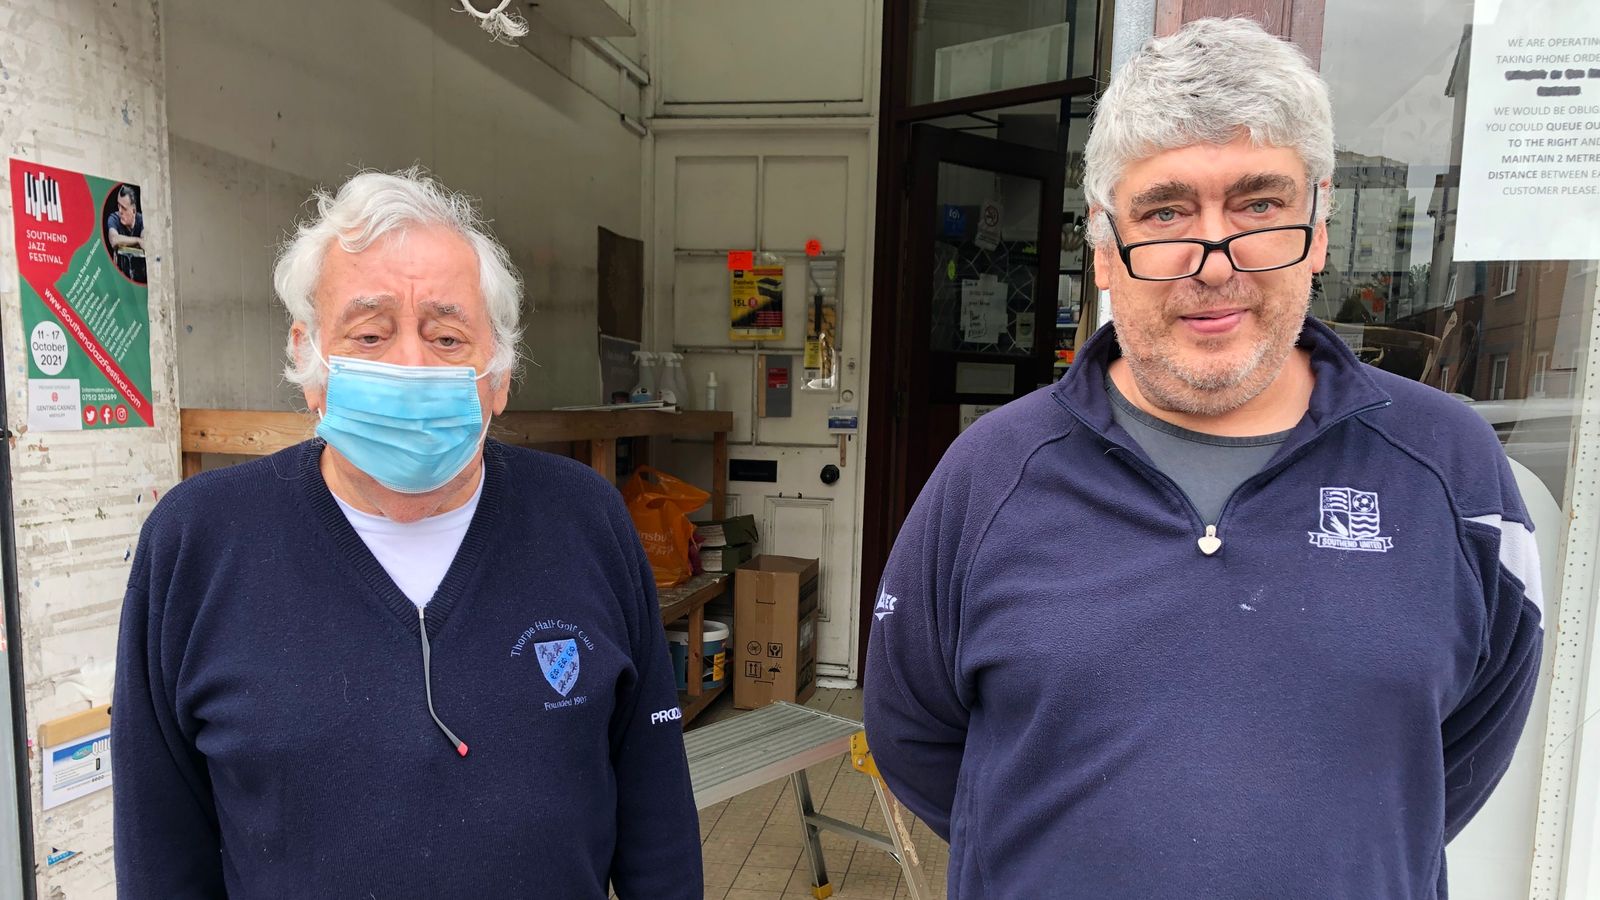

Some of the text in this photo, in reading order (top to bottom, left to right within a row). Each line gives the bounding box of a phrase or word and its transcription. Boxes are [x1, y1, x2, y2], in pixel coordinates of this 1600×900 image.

[1508, 38, 1524, 47] WE
[1527, 38, 1545, 47] ARE
[1496, 54, 1533, 64] TAKING
[1535, 54, 1571, 63] PHONE
[1494, 106, 1510, 116] WE
[1513, 106, 1551, 115] WOULD
[1553, 105, 1566, 115] BE
[1486, 122, 1507, 132] YOU
[1509, 122, 1544, 131] COULD
[1546, 121, 1582, 131] QUEUE
[1508, 138, 1522, 148] TO
[1525, 138, 1545, 147] THE
[1547, 137, 1578, 147] RIGHT
[1501, 154, 1555, 164] MAINTAIN
[1557, 154, 1563, 163] 2
[1488, 170, 1538, 180] DISTANCE
[1541, 169, 1589, 179] BETWEEN
[1502, 185, 1559, 196] CUSTOMER
[26, 229, 68, 244] SOUTHEND
[28, 241, 46, 251] JAZZ
[29, 252, 63, 265] FESTIVAL
[38, 330, 44, 339] 11
[52, 330, 60, 340] 17
[33, 341, 65, 352] October
[45, 288, 141, 408] www.SouthendJazzFestival.com
[41, 354, 62, 366] 2021
[1322, 537, 1383, 550] SOUTHEND UNITED
[510, 626, 536, 657] Thorpe
[556, 619, 578, 633] Golf
[544, 698, 573, 711] Founded
